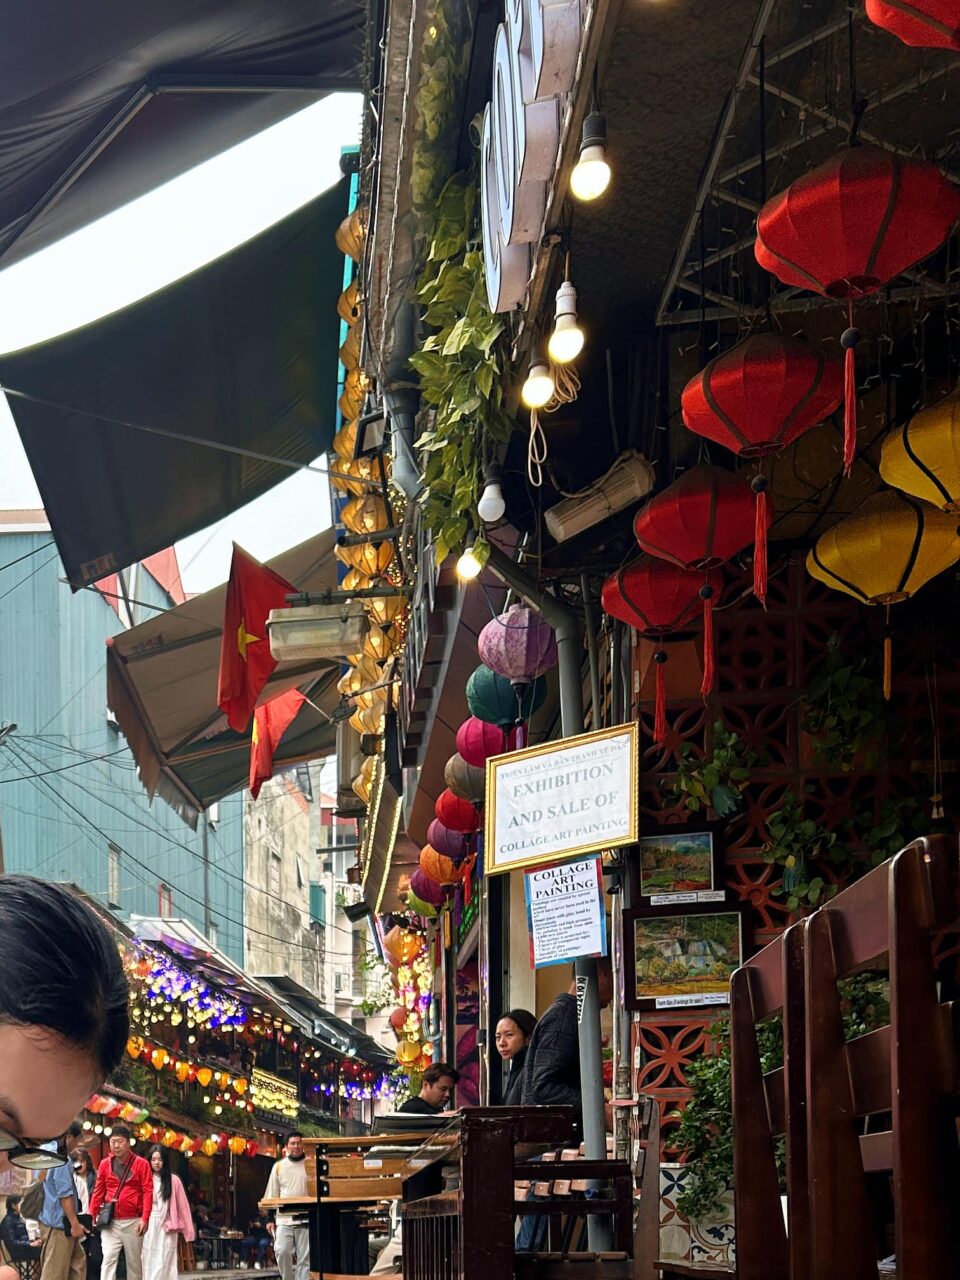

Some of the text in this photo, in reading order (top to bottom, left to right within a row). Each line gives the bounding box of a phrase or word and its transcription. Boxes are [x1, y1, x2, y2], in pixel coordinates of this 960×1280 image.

[513, 762, 614, 798] EXHIBITION
[508, 790, 619, 829] AND SALE OF
[500, 817, 627, 854] COLLAGE ART PAINTING
[534, 862, 593, 882] COLLAGE
[552, 874, 576, 887] ART
[536, 879, 593, 899] PAINTING
